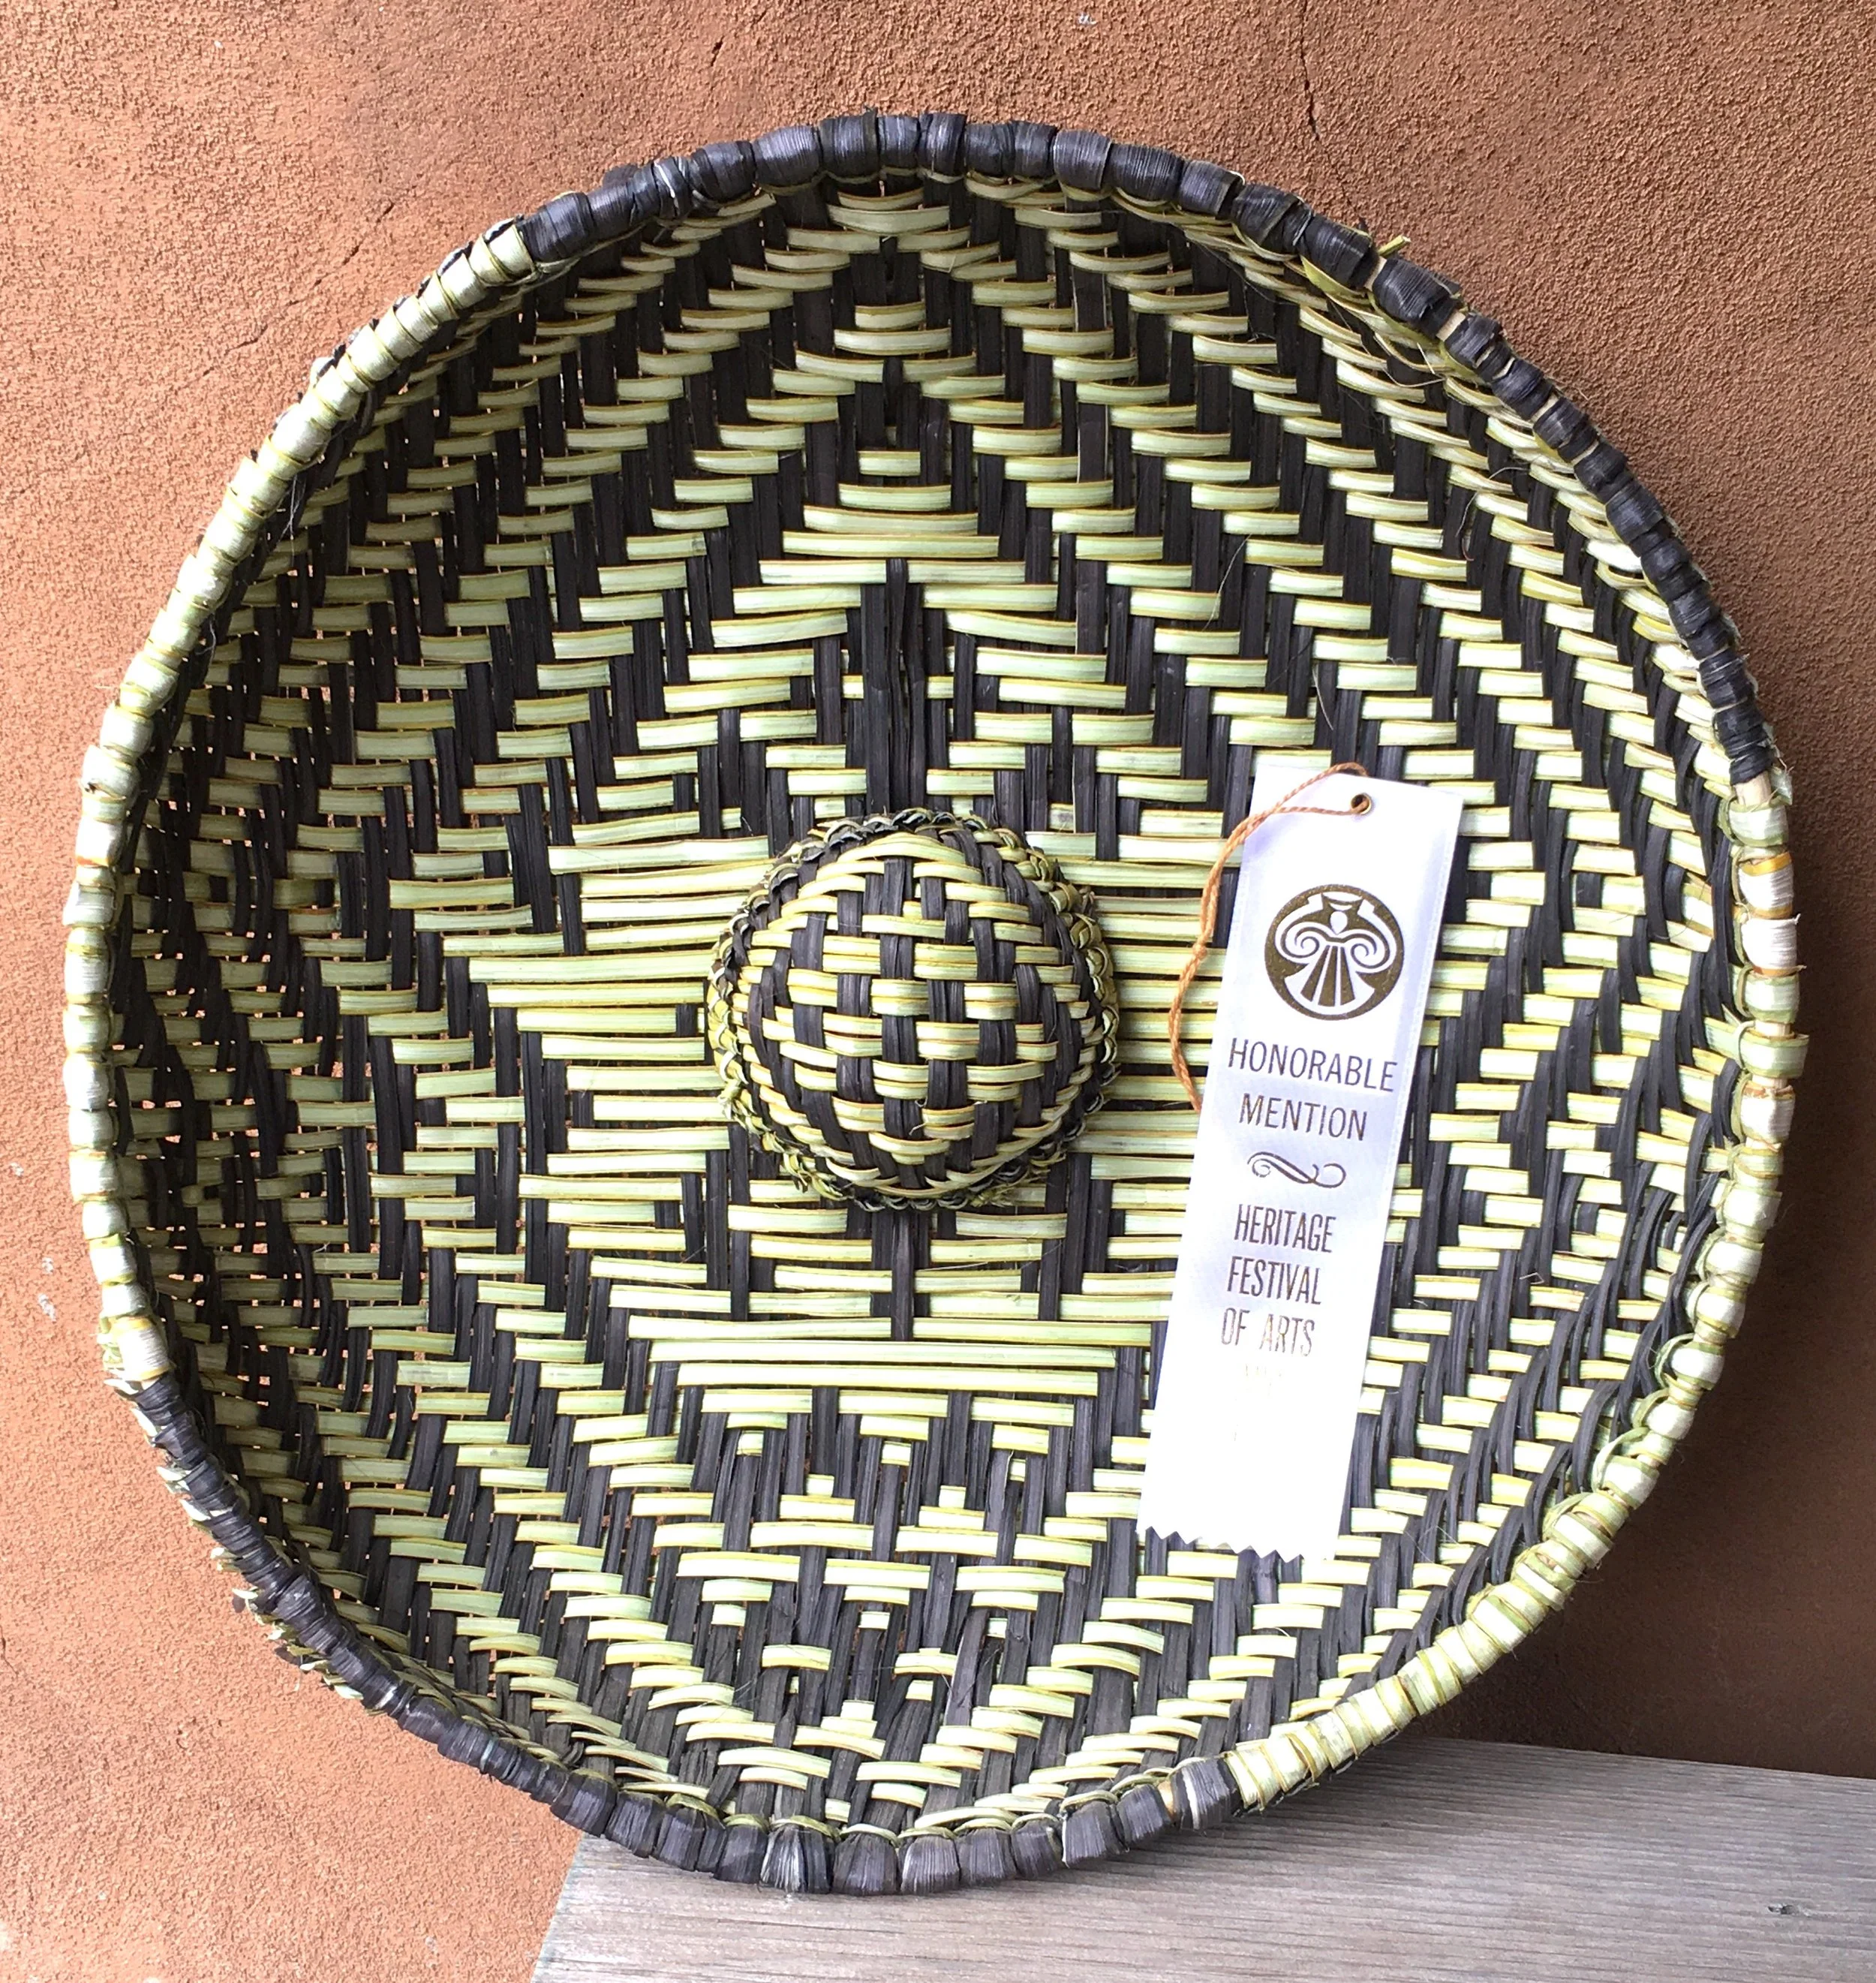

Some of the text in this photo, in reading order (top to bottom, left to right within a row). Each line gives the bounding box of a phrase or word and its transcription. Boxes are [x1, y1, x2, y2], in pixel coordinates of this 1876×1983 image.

[1228, 1037, 1398, 1092] HONORABLE
[1239, 1093, 1368, 1141] MENTION
[1234, 1203, 1337, 1253] HERITAGE
[1227, 1256, 1321, 1305] FESTIVAL
[1220, 1307, 1315, 1357] OF ARTS
